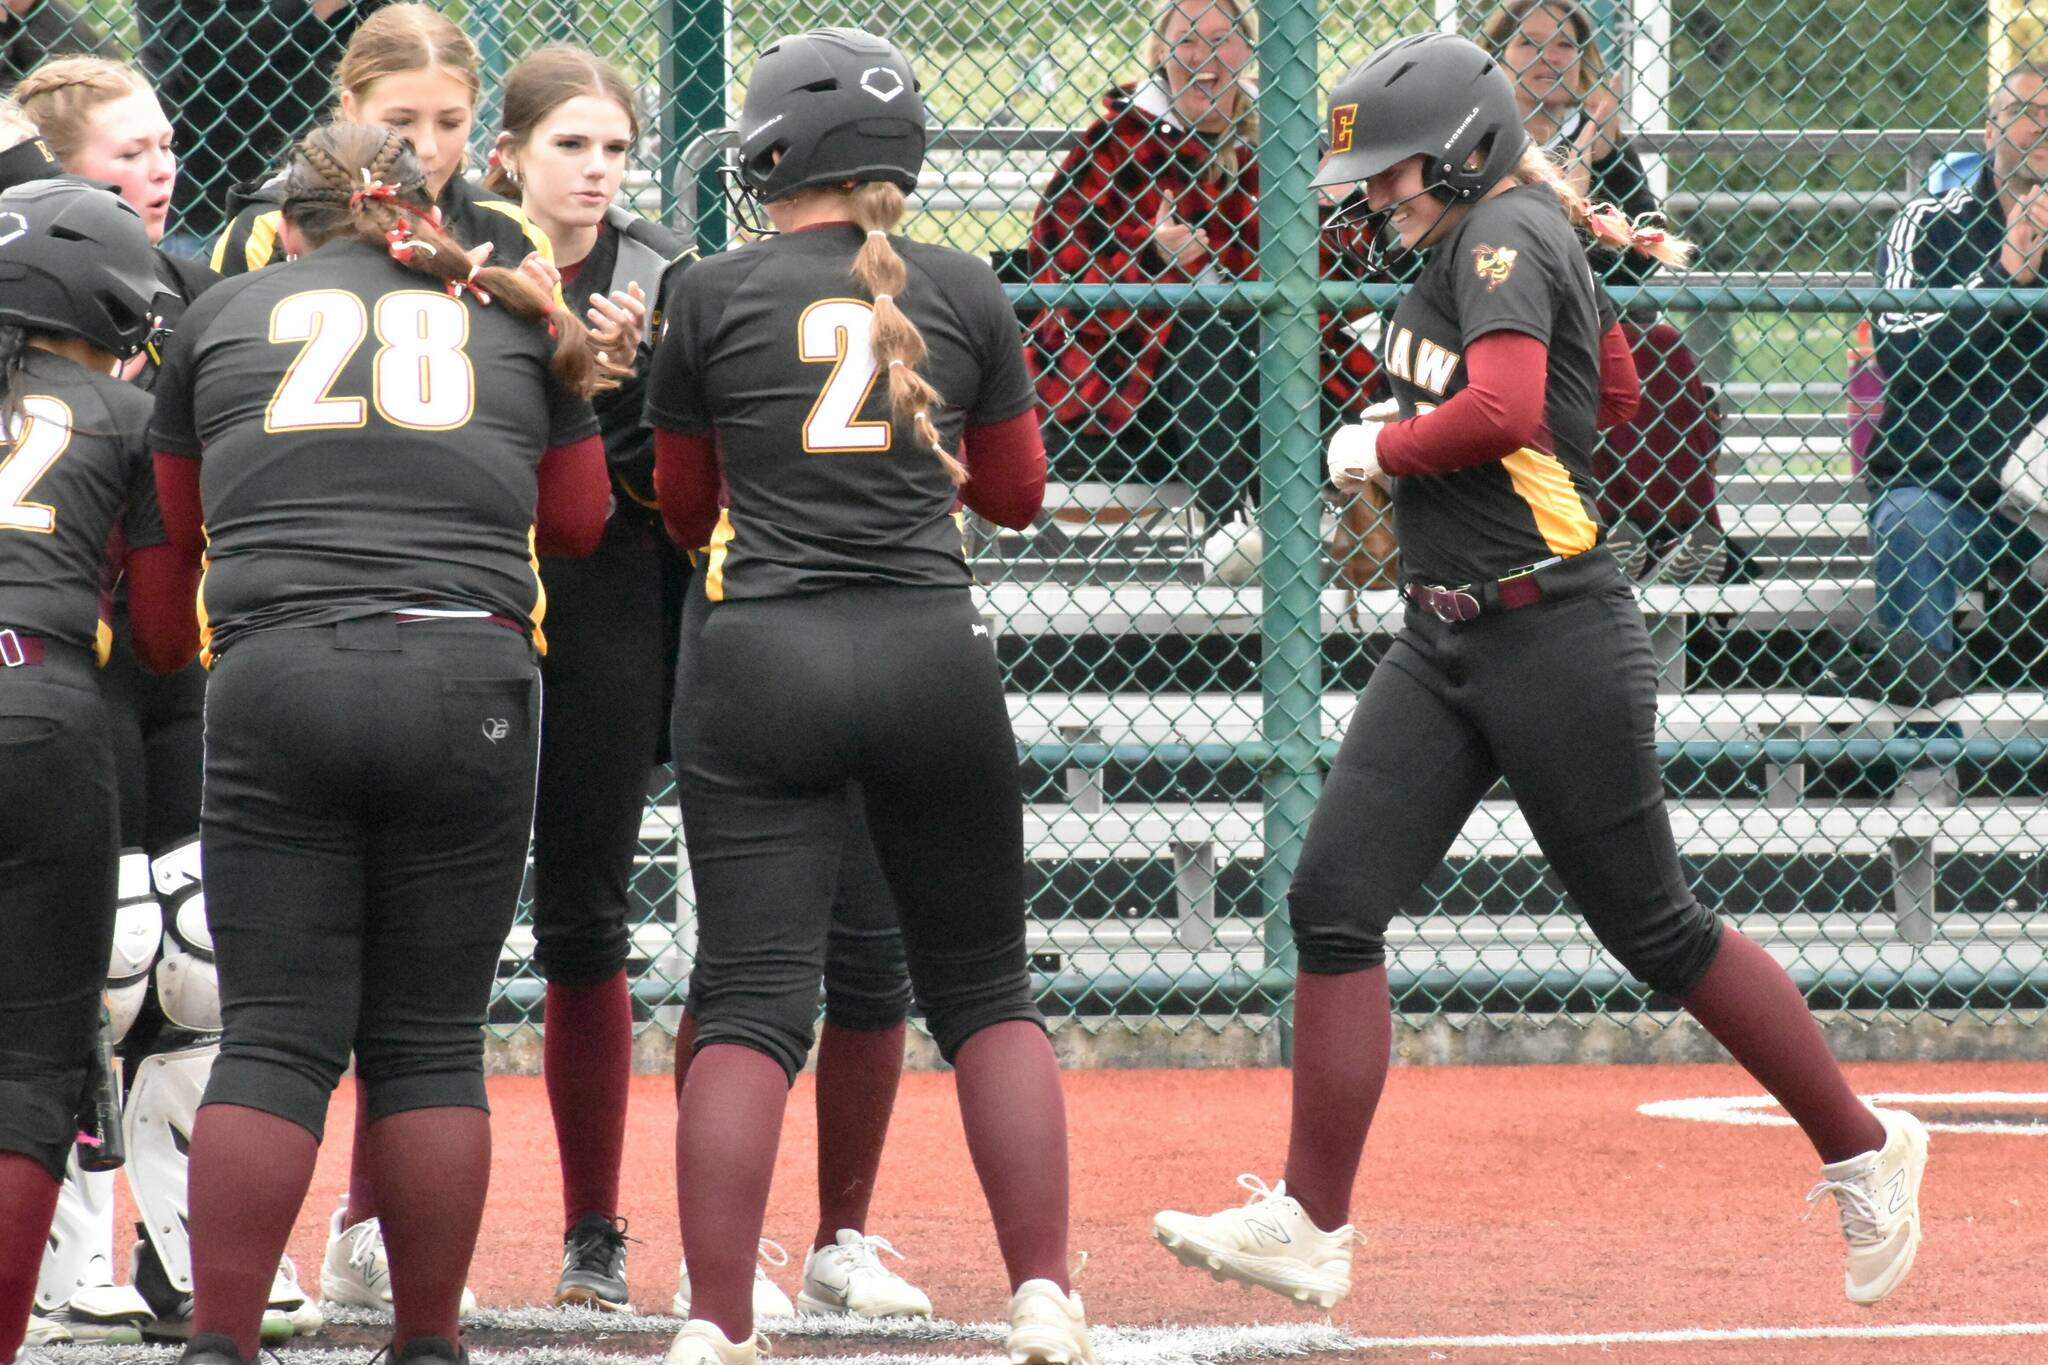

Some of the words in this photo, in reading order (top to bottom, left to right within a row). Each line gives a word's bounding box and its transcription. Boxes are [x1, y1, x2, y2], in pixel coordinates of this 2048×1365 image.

[1330, 103, 1358, 154] E
[264, 288, 475, 433] 28
[798, 298, 892, 453] 2
